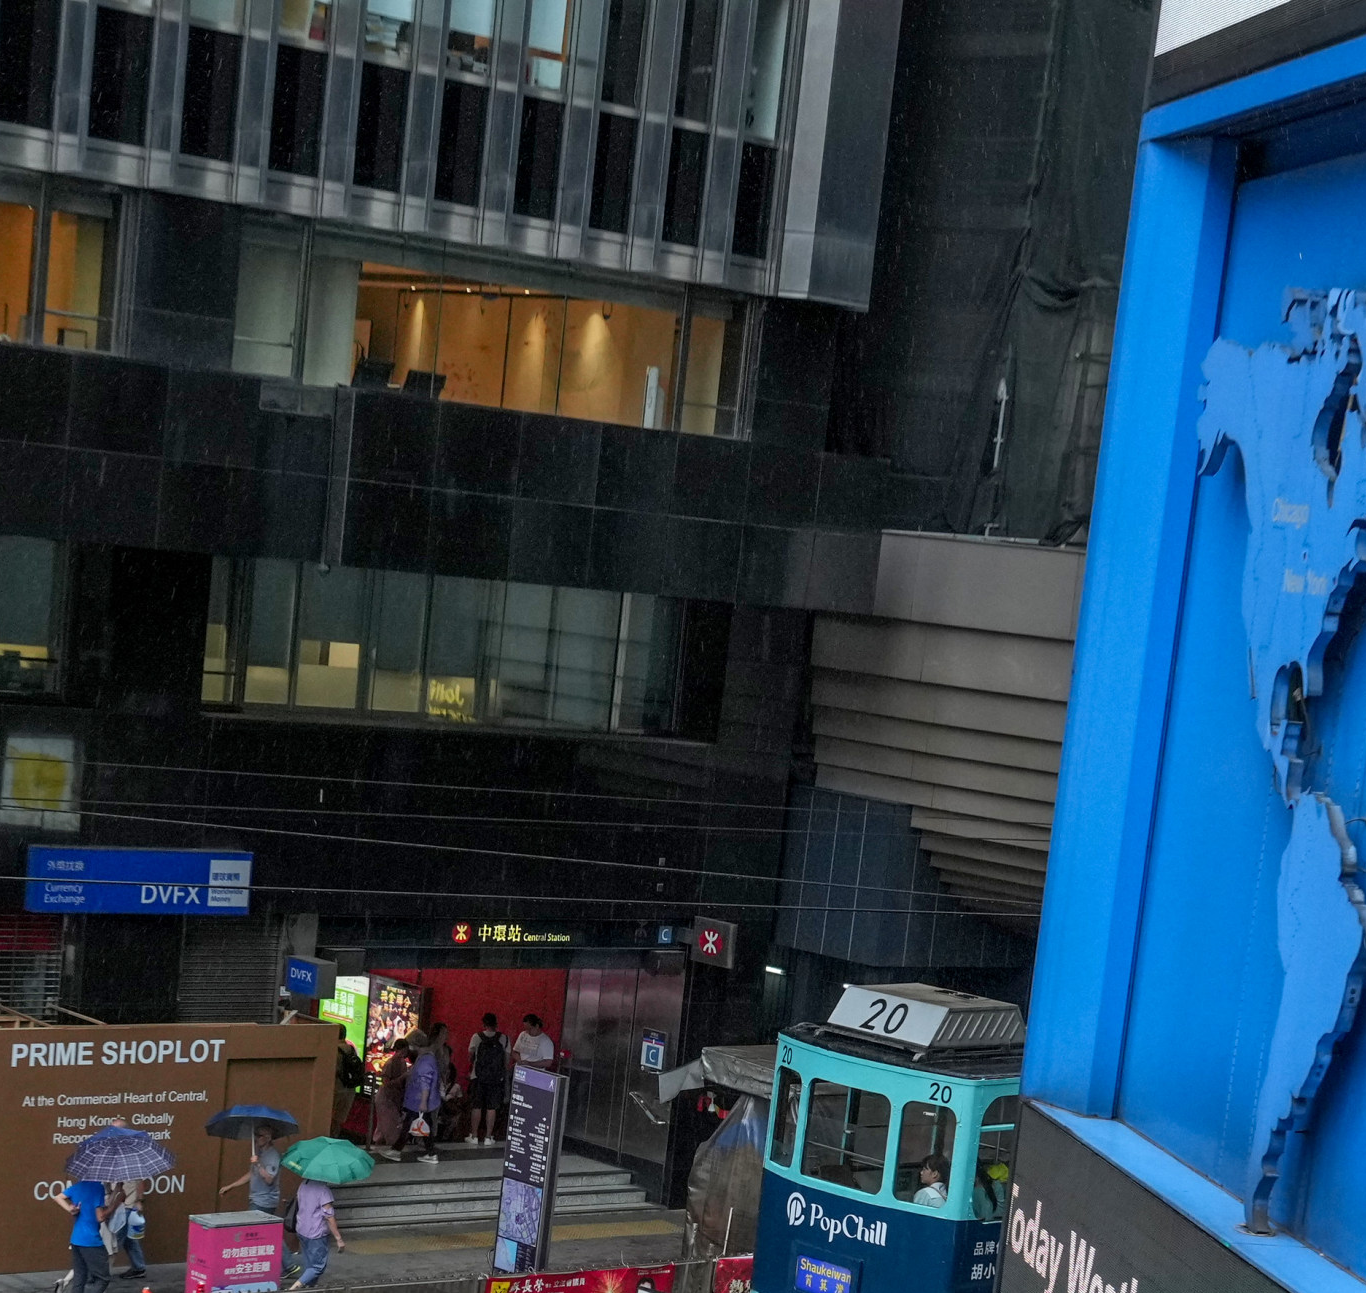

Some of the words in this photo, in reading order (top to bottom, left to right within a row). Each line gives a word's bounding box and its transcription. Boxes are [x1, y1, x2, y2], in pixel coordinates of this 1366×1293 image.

[45, 882, 83, 894] Currency
[140, 885, 201, 905] DVFX
[44, 893, 85, 904] Exchange
[478, 924, 522, 942] 中環站
[523, 932, 547, 942] Central
[547, 932, 571, 942] Station
[290, 967, 313, 983] DVFX
[859, 998, 909, 1034] 20
[11, 1041, 94, 1067] PRIME
[101, 1039, 226, 1065] SHOPLOT
[782, 1045, 793, 1065] 20
[22, 1095, 36, 1107] At
[37, 1095, 55, 1106] the
[56, 1092, 121, 1106] Commercial
[123, 1091, 153, 1104] Heart
[155, 1091, 167, 1102] of
[168, 1089, 209, 1103] Central,
[929, 1082, 952, 1104] 20
[57, 1116, 86, 1130] Hong
[131, 1112, 175, 1126] Globally
[810, 1203, 888, 1247] PopChill
[800, 1258, 852, 1283] Shaukeiwan
